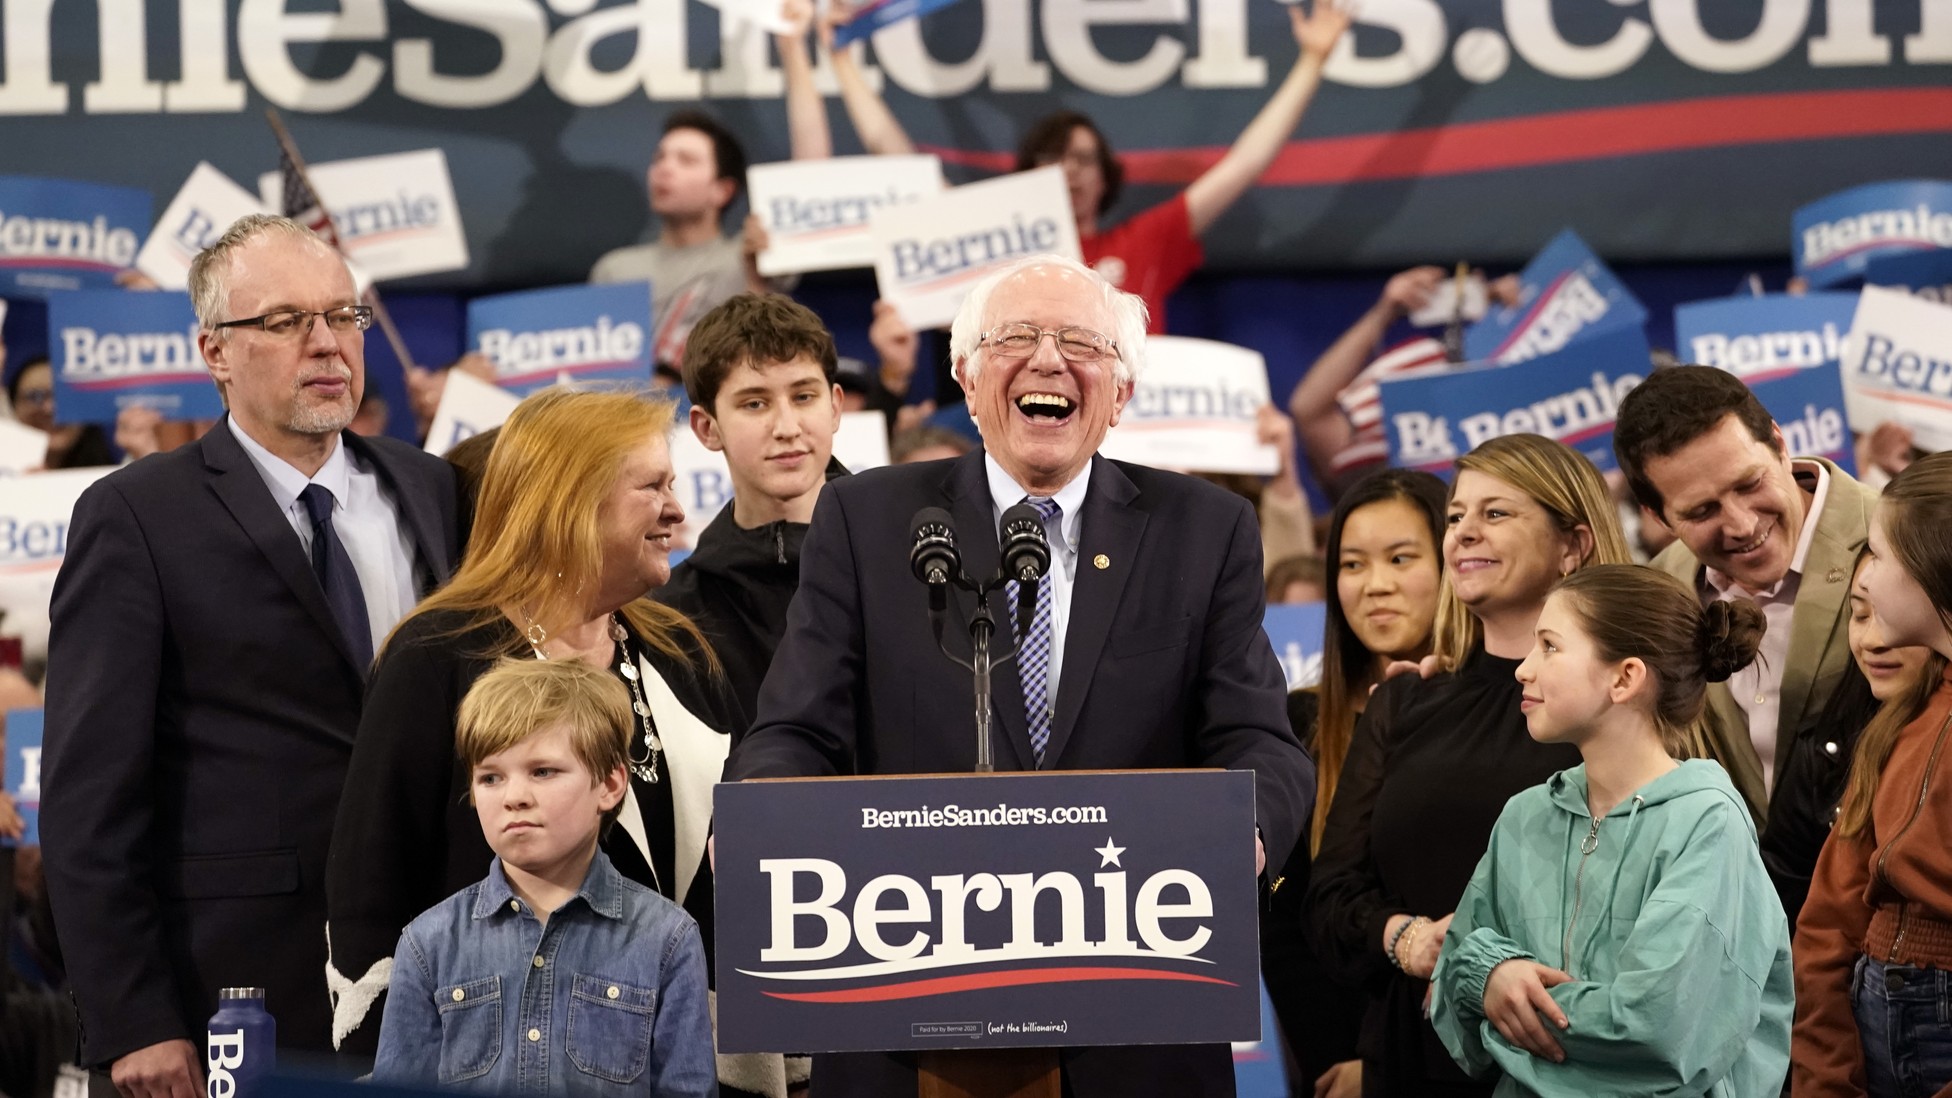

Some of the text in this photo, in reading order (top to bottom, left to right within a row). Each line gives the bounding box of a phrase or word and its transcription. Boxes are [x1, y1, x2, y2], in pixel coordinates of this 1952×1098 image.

[0, 210, 138, 267] ernie
[889, 212, 1058, 280] Bernie
[1129, 377, 1259, 419] ernie
[861, 803, 1108, 829] BernieSanders.com
[759, 836, 1214, 964] Bernie
[987, 1020, 1068, 1036] (not the billionaires)
